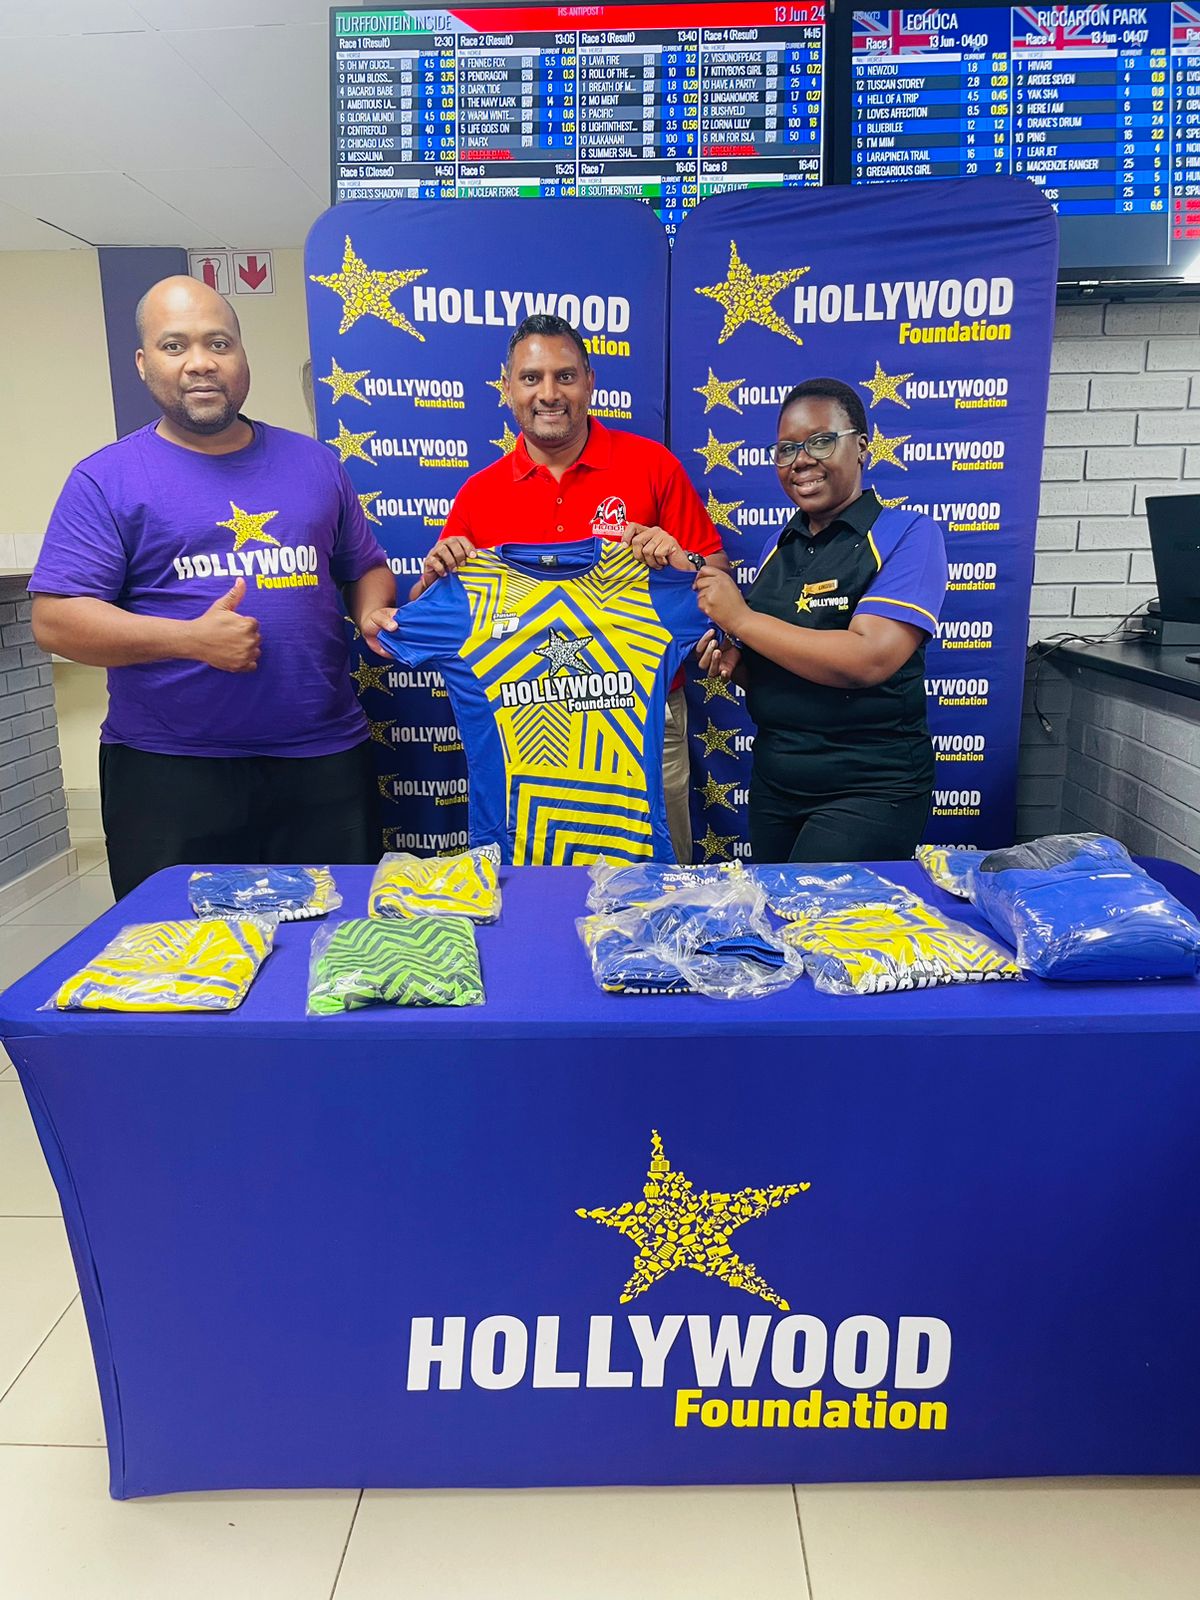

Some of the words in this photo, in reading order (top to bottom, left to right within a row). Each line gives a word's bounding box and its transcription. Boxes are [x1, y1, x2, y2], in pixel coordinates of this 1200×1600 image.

[775, 7, 786, 22] 13
[789, 7, 806, 21] Jun
[810, 6, 825, 20] 24
[1038, 11, 1109, 26] RICCARTON
[1113, 8, 1147, 24] PARK
[337, 16, 410, 32] TURFFONTEIN
[415, 15, 452, 31] INSIDE
[907, 14, 958, 30] ECHUCA
[582, 34, 600, 43] Race
[601, 34, 606, 43] 3
[608, 32, 635, 43] (Result)
[678, 32, 697, 41] 13:40
[704, 31, 723, 40] Race
[723, 31, 728, 40] 4
[730, 29, 757, 40] (Result)
[804, 28, 821, 38] 14:15
[1091, 32, 1101, 43] 13
[1103, 32, 1116, 43] Jun
[1124, 30, 1148, 42] 04:07
[339, 39, 356, 49] Race
[358, 38, 361, 48] 1
[363, 37, 390, 48] (Result)
[434, 36, 453, 46] 12:30
[461, 37, 478, 46] Race
[479, 36, 484, 45] 2
[486, 35, 513, 45] (Result)
[555, 34, 574, 44] 13:05
[866, 37, 887, 49] Race
[888, 37, 892, 48] 1
[929, 35, 939, 48] 13
[940, 35, 954, 47] Jun
[962, 34, 988, 46] 04:00
[1026, 34, 1049, 45] Race
[1050, 34, 1055, 44] 4
[589, 56, 604, 65] LAVA
[605, 56, 619, 64] FIRE
[711, 52, 762, 62] VISIONOFPEACE
[468, 58, 492, 67] FENNEC
[494, 58, 505, 66] FOX
[468, 71, 508, 80] PENDRAGON
[747, 66, 762, 75] GIRL
[868, 79, 895, 89] TUSCAN
[897, 79, 925, 89] STOREY
[1028, 75, 1050, 85] ARDEE
[1051, 74, 1075, 84] SEVEN
[348, 86, 376, 96] BACARDI
[378, 86, 394, 95] BABE
[468, 85, 484, 94] DARK
[468, 98, 479, 107] THE
[481, 98, 496, 107] NAVY
[498, 97, 516, 107] LARK
[589, 96, 600, 105] MO
[602, 96, 618, 105] MENT
[711, 92, 758, 102] LINGANOMORE
[868, 94, 883, 104] HELL
[886, 94, 895, 104] OF
[903, 94, 918, 103] TRIP
[589, 109, 613, 118] PACIFIC
[711, 106, 745, 115] BUSHVELD
[868, 109, 888, 119] LOVES
[890, 107, 927, 118] AFFECTION
[348, 113, 370, 122] GLORIA
[371, 112, 394, 121] MUNDI
[711, 119, 732, 129] LORNA
[734, 119, 750, 129] LILLY
[867, 122, 903, 133] BLUEBILEE
[1060, 118, 1082, 127] DRUM
[348, 126, 387, 135] CENTREFOLD
[468, 124, 480, 133] LIFE
[482, 124, 498, 133] GOES
[500, 123, 509, 133] ON
[589, 135, 624, 144] ALAKANANI
[1027, 132, 1045, 142] PING
[348, 139, 377, 148] CHICAGO
[379, 138, 394, 147] LASS
[879, 138, 894, 147] MIM
[348, 152, 383, 161] MESSALINA
[867, 151, 908, 162] LARAPINETA
[910, 151, 930, 160] TRAIL
[1027, 147, 1043, 156] LEAR
[1045, 147, 1057, 156] JET
[555, 164, 574, 174] 15:25
[582, 165, 600, 174] Race
[601, 164, 604, 173] 7
[676, 163, 696, 173] 16:05
[703, 162, 721, 171] Race
[722, 162, 727, 171] 8
[799, 160, 818, 170] 16:40
[1027, 160, 1067, 170] MACKENZIE
[1069, 160, 1098, 169] RANGER
[340, 168, 357, 177] Race
[358, 167, 364, 176] 5
[366, 166, 394, 176] (Closed)
[434, 166, 453, 176] 14:50
[461, 166, 478, 175] Race
[479, 166, 484, 175] 6
[867, 165, 912, 176] GREGARIOUS
[915, 165, 931, 174] GIRL
[375, 189, 403, 198] SHADOW
[468, 188, 497, 197] NUCLEAR
[499, 188, 519, 196] FORCE
[589, 186, 623, 196] SOUTHERN
[625, 186, 642, 195] STYLE
[794, 278, 1013, 323] HOLLYWOOD
[899, 321, 1010, 344] Foundation
[365, 378, 464, 398] HOLLYWOOD
[906, 378, 1008, 399] HOLLYWOOD
[738, 386, 796, 405] HOLLY
[414, 397, 465, 409] Foundation
[955, 397, 1008, 409] Foundation
[587, 408, 632, 419] oundation
[371, 438, 468, 457] HOLLYWOOD
[904, 441, 1005, 461] HOLLYWOOD
[420, 457, 469, 468] Foundation
[952, 460, 1003, 470] Foundation
[376, 498, 455, 516] HOLLYWO
[949, 521, 1000, 531] Foundation
[172, 546, 318, 580] HOLLYWOOD
[256, 572, 318, 589] Foundation
[946, 581, 995, 590] Foundation
[810, 597, 848, 608] HOLLYWOOD
[934, 622, 993, 638] YWOOD
[942, 639, 992, 648] Foundation
[388, 672, 445, 687] HOLLYW
[502, 672, 633, 707] HOLLYWOOD
[924, 679, 988, 695] LYWOOD
[568, 696, 634, 712] Foundation
[939, 696, 988, 705] Foundation
[392, 726, 461, 742] HOLLYWO
[932, 735, 985, 751] YWOOD
[936, 752, 984, 761] Foundation
[394, 778, 470, 796] HOLLYWOO
[932, 806, 980, 816] Foundation
[396, 831, 470, 849] HOLLYWOO
[407, 1315, 952, 1390] HOLLYWOOD
[674, 1390, 948, 1429] Foundation
